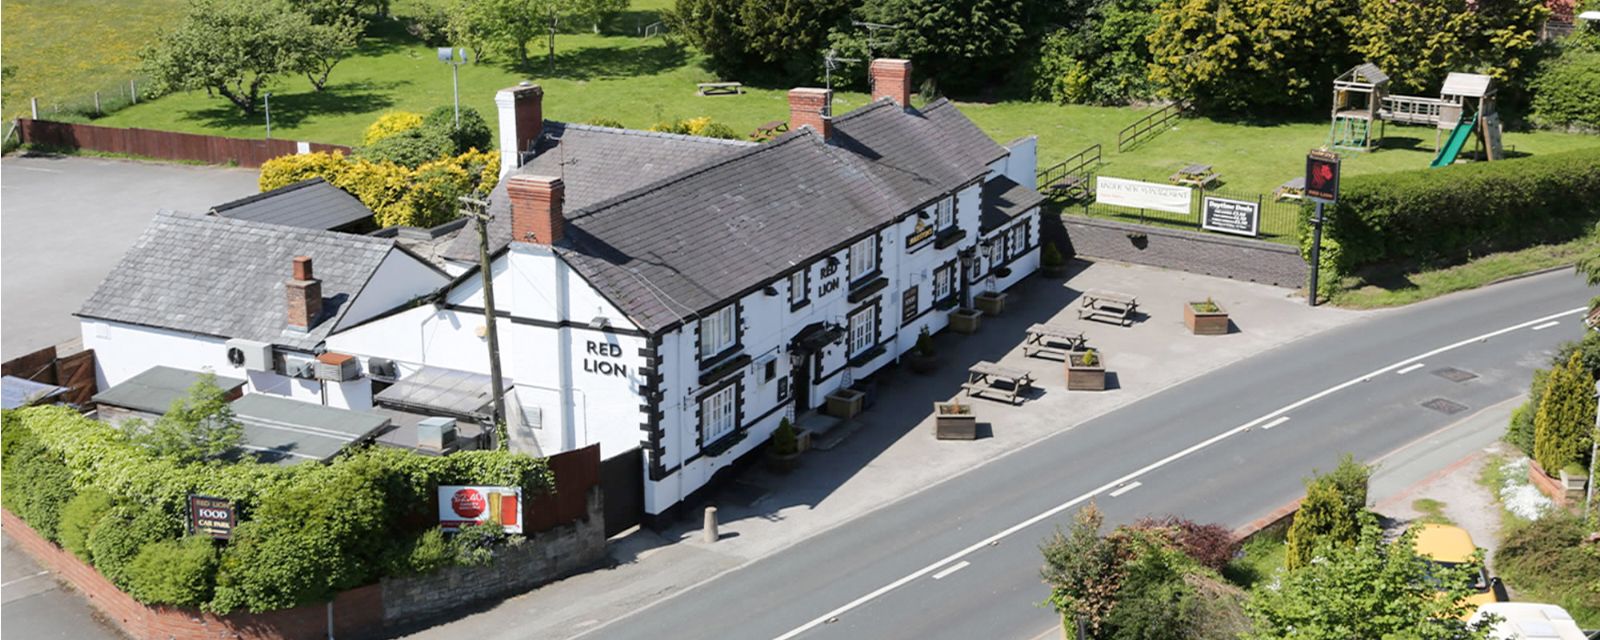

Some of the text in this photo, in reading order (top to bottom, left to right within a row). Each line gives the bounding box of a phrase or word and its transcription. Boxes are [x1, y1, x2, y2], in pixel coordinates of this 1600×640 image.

[820, 261, 837, 280] RED
[818, 277, 839, 298] LION
[586, 340, 622, 358] RED
[584, 358, 627, 378] LION
[199, 509, 227, 519] FOOD
